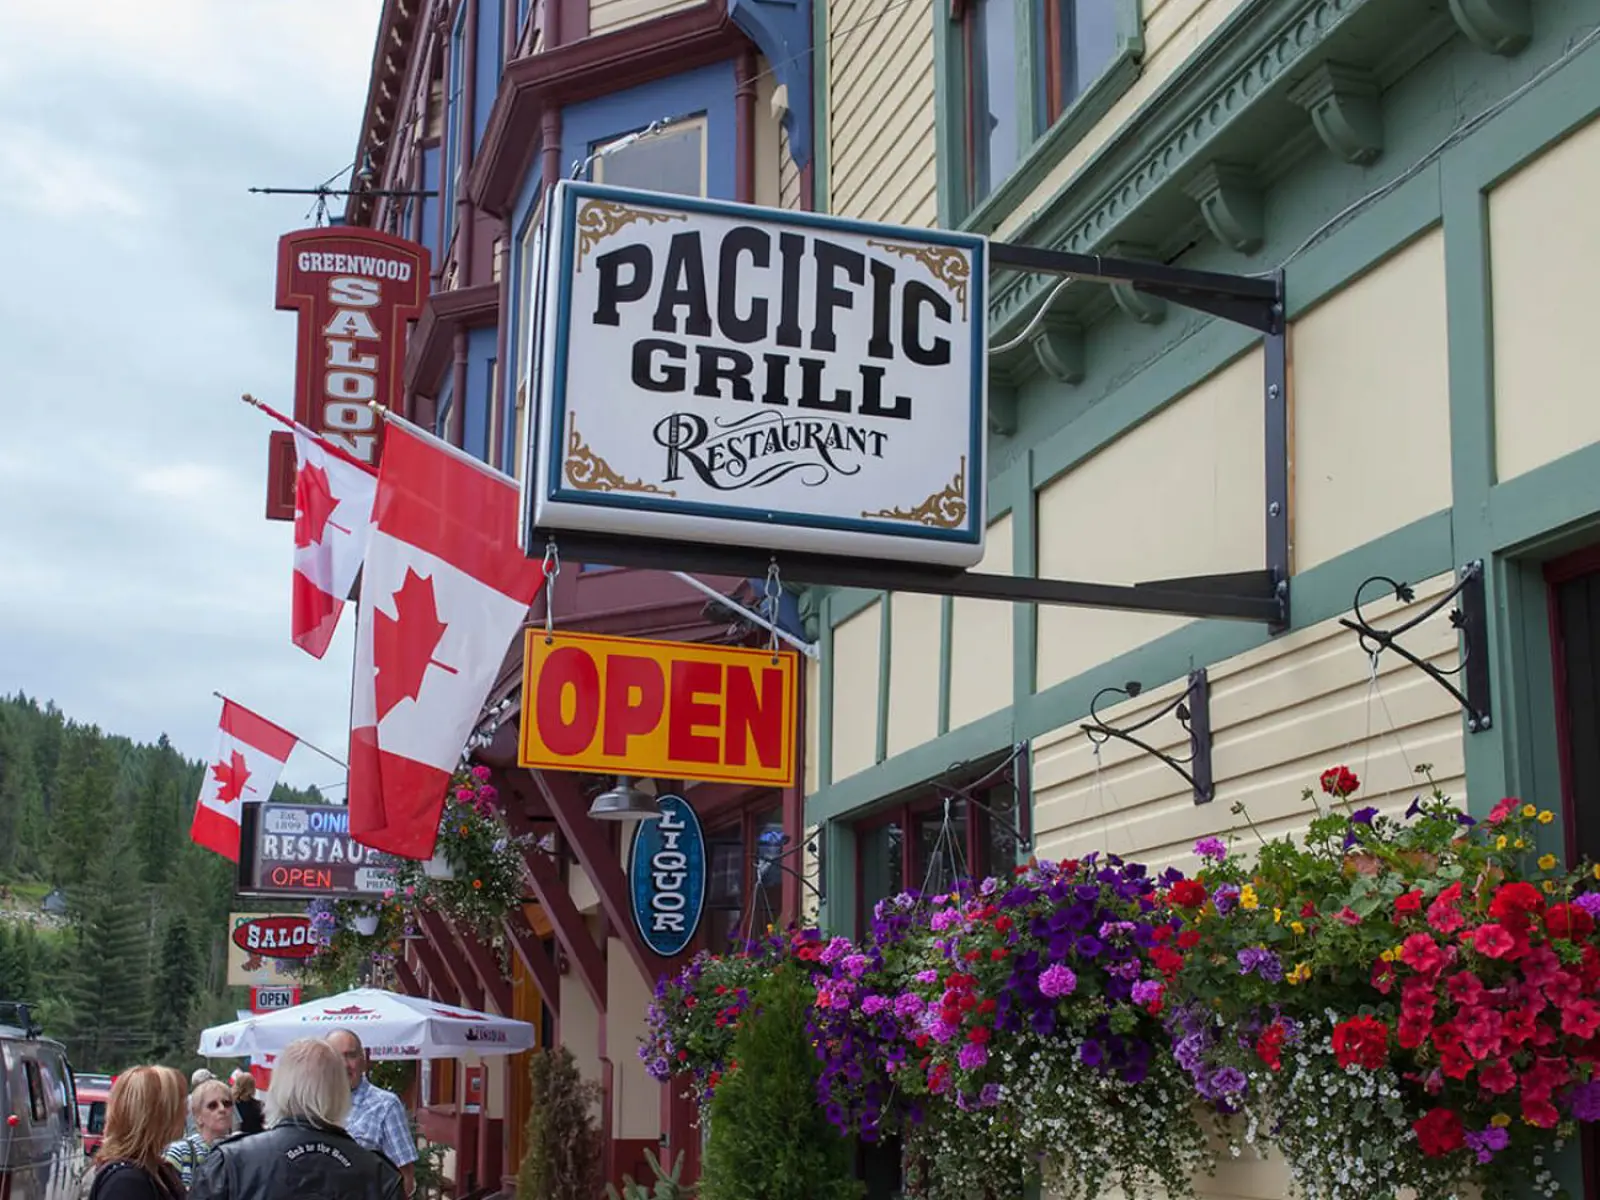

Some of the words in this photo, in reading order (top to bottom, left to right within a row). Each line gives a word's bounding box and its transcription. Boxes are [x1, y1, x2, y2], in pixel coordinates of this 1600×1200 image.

[298, 251, 411, 282] GREENWOOD
[593, 226, 952, 366] PACIFIC
[323, 277, 381, 465] SALOON
[631, 338, 912, 420] GRILL
[536, 646, 784, 769] OPEN
[310, 812, 349, 834] DINI
[262, 834, 379, 865] RESTAU
[271, 866, 332, 889] OPEN
[652, 810, 688, 932] LIQUOR
[247, 924, 318, 949] SALOO
[259, 992, 290, 1007] OPEN
